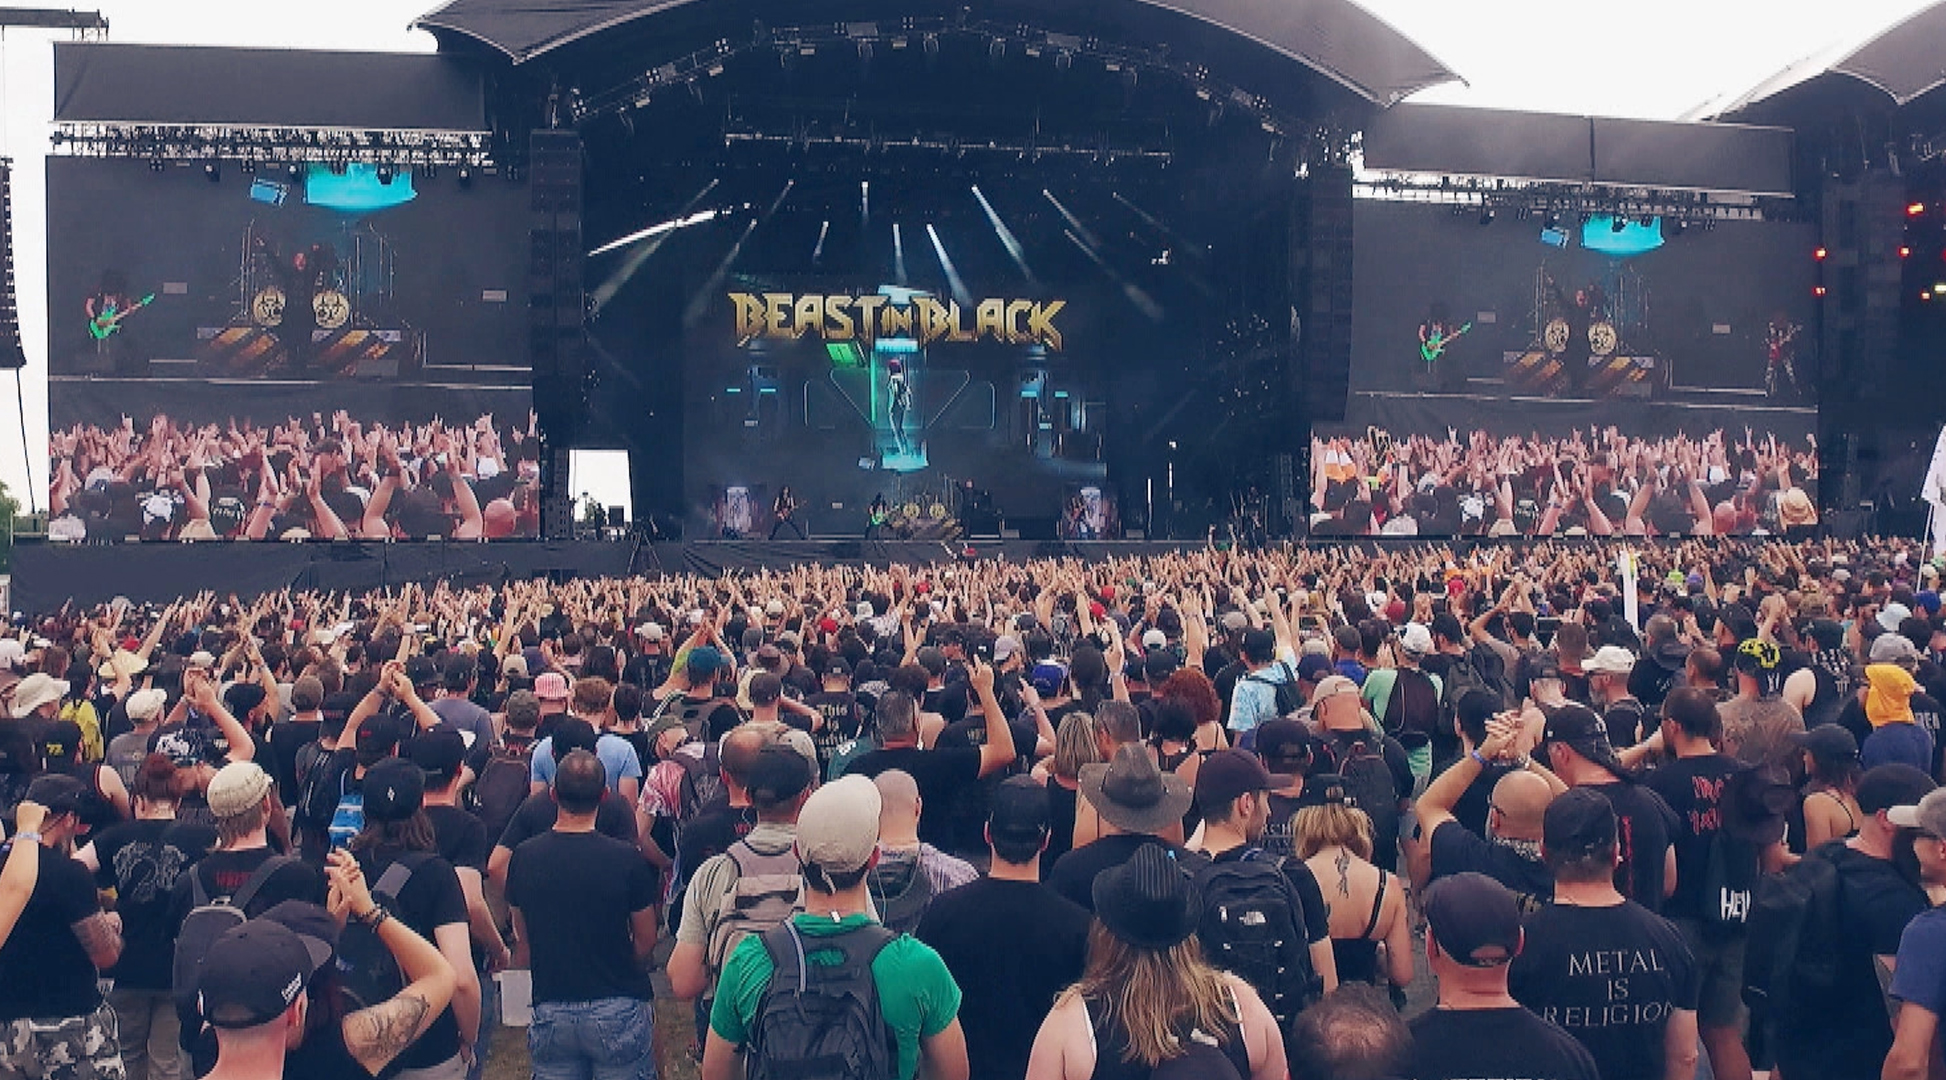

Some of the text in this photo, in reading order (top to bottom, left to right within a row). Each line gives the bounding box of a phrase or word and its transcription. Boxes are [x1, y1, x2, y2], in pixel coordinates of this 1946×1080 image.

[728, 293, 1067, 353] BEAST IN BLACK
[1568, 948, 1664, 976] METAL
[1608, 978, 1629, 1001] IS
